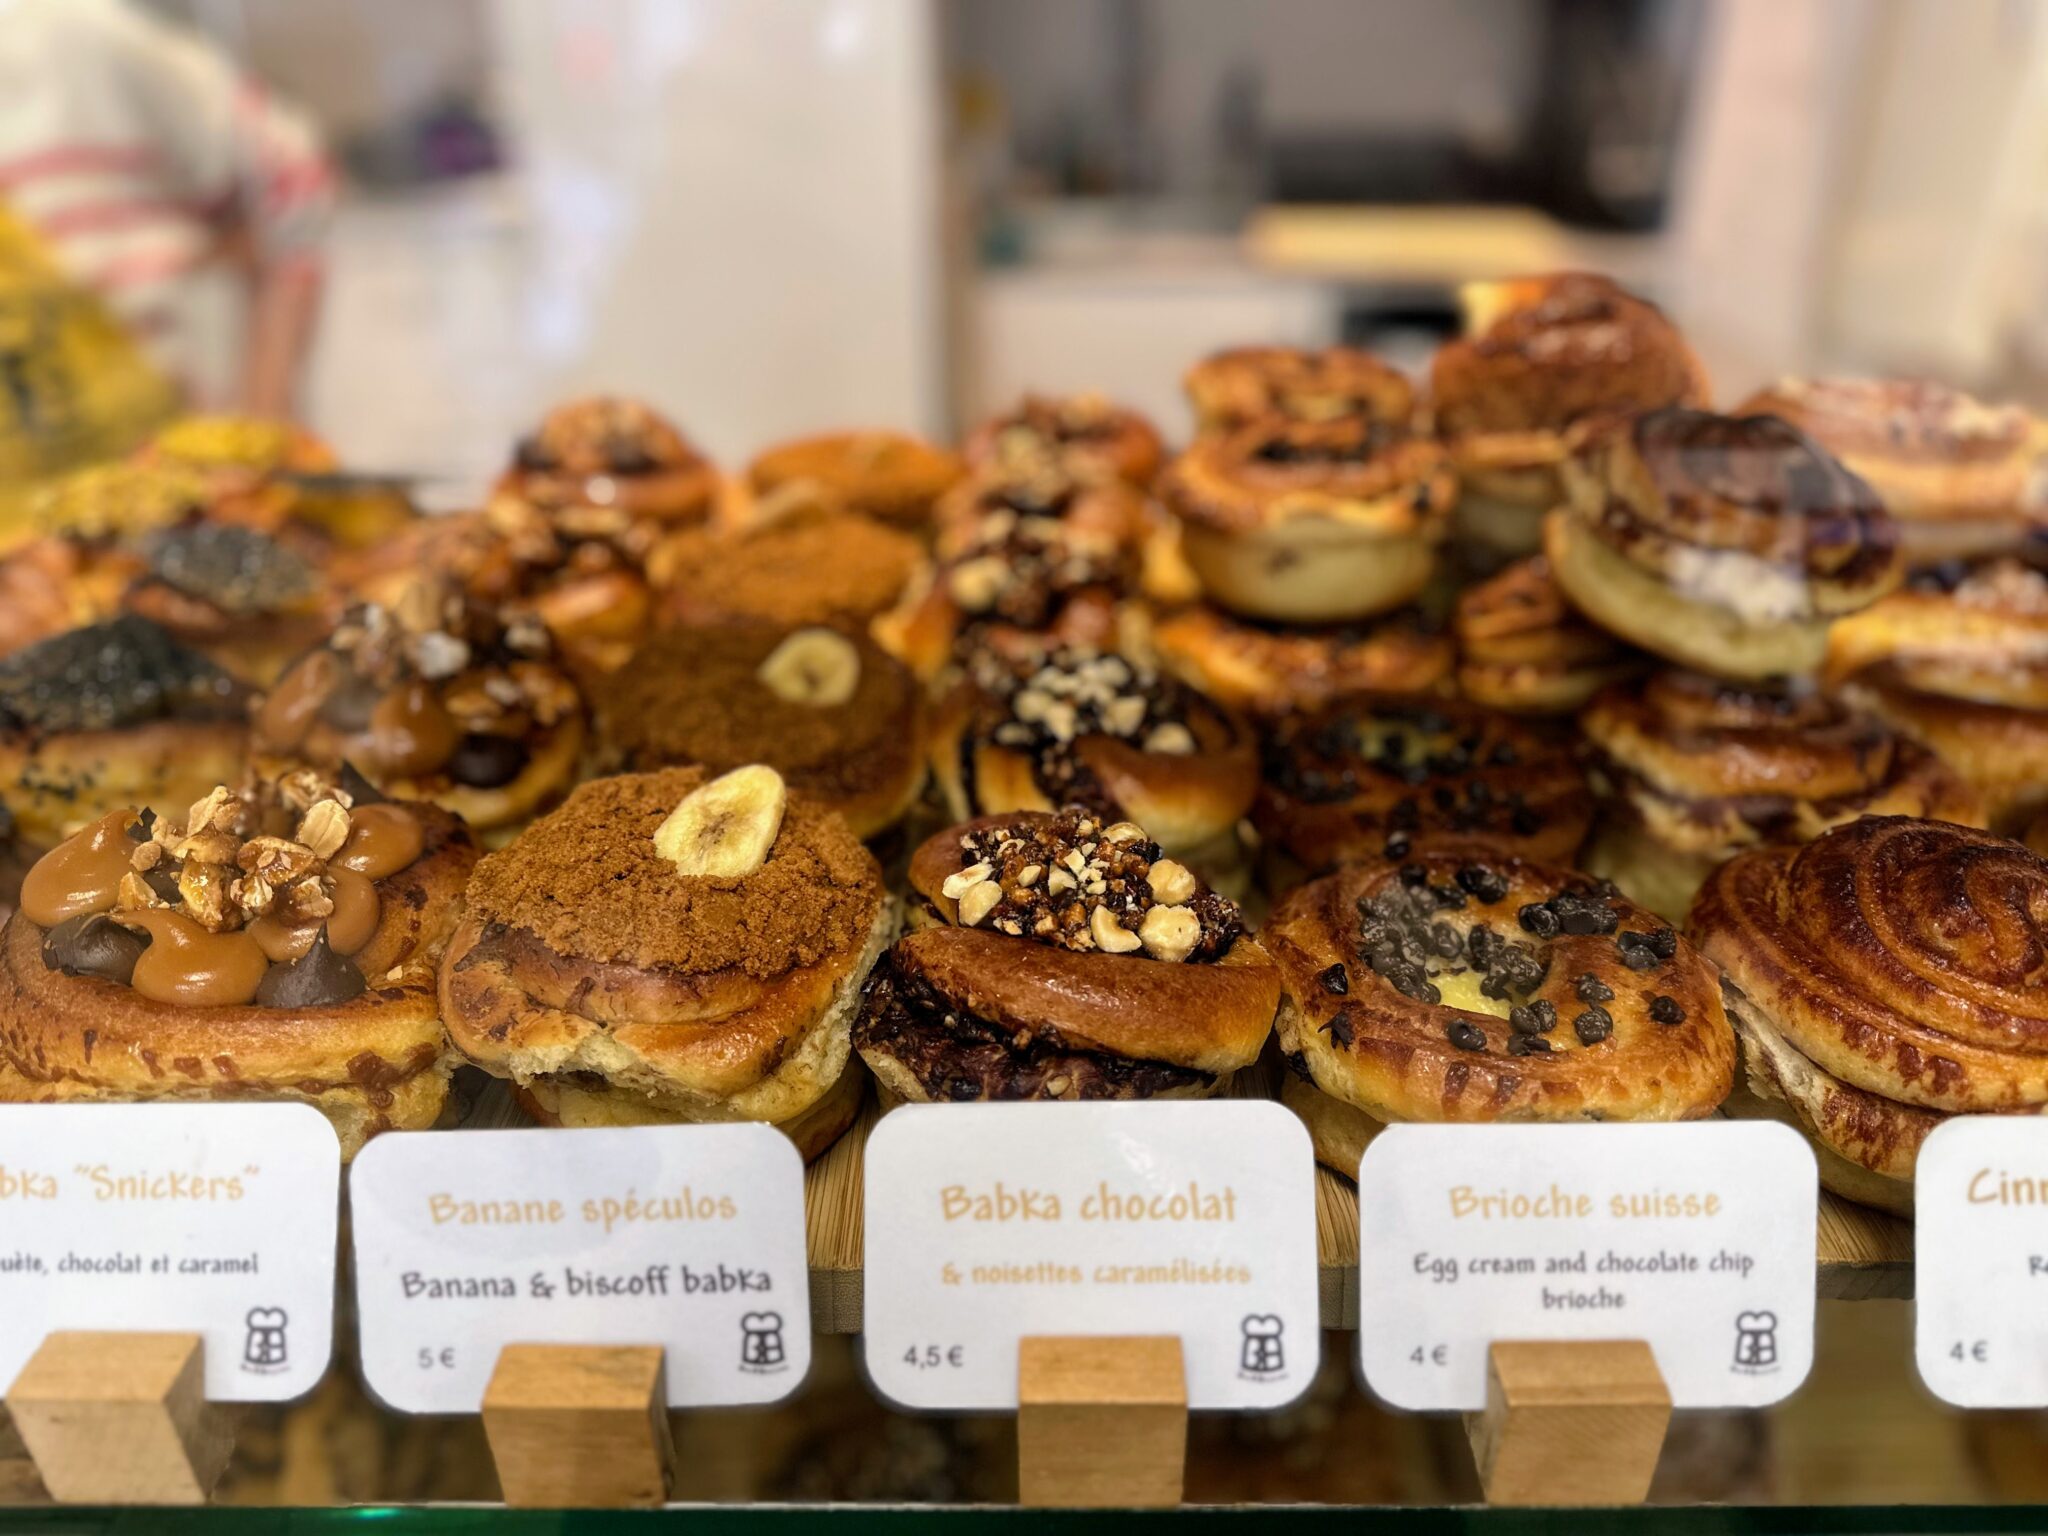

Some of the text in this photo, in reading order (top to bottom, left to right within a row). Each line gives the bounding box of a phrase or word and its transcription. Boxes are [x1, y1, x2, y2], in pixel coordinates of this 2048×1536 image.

[428, 1186, 737, 1233] Banane spéculos
[940, 1181, 1236, 1222] Babka chocolat
[1448, 1183, 1720, 1220] Brioche suisse
[57, 1251, 142, 1274] chocolat
[150, 1255, 169, 1273] et
[178, 1252, 258, 1274] caramel
[941, 1262, 963, 1286] &
[971, 1262, 1083, 1285] noisettes
[1413, 1249, 1754, 1283] Egg cream and chocolate chip
[400, 1263, 772, 1299] Banana & biscoff babka
[1541, 1286, 1626, 1309] brioche
[418, 1347, 454, 1369] 5 €
[903, 1345, 963, 1369] 4,5 €
[1410, 1345, 1447, 1366] 4 €
[1949, 1340, 1987, 1362] 4 €
